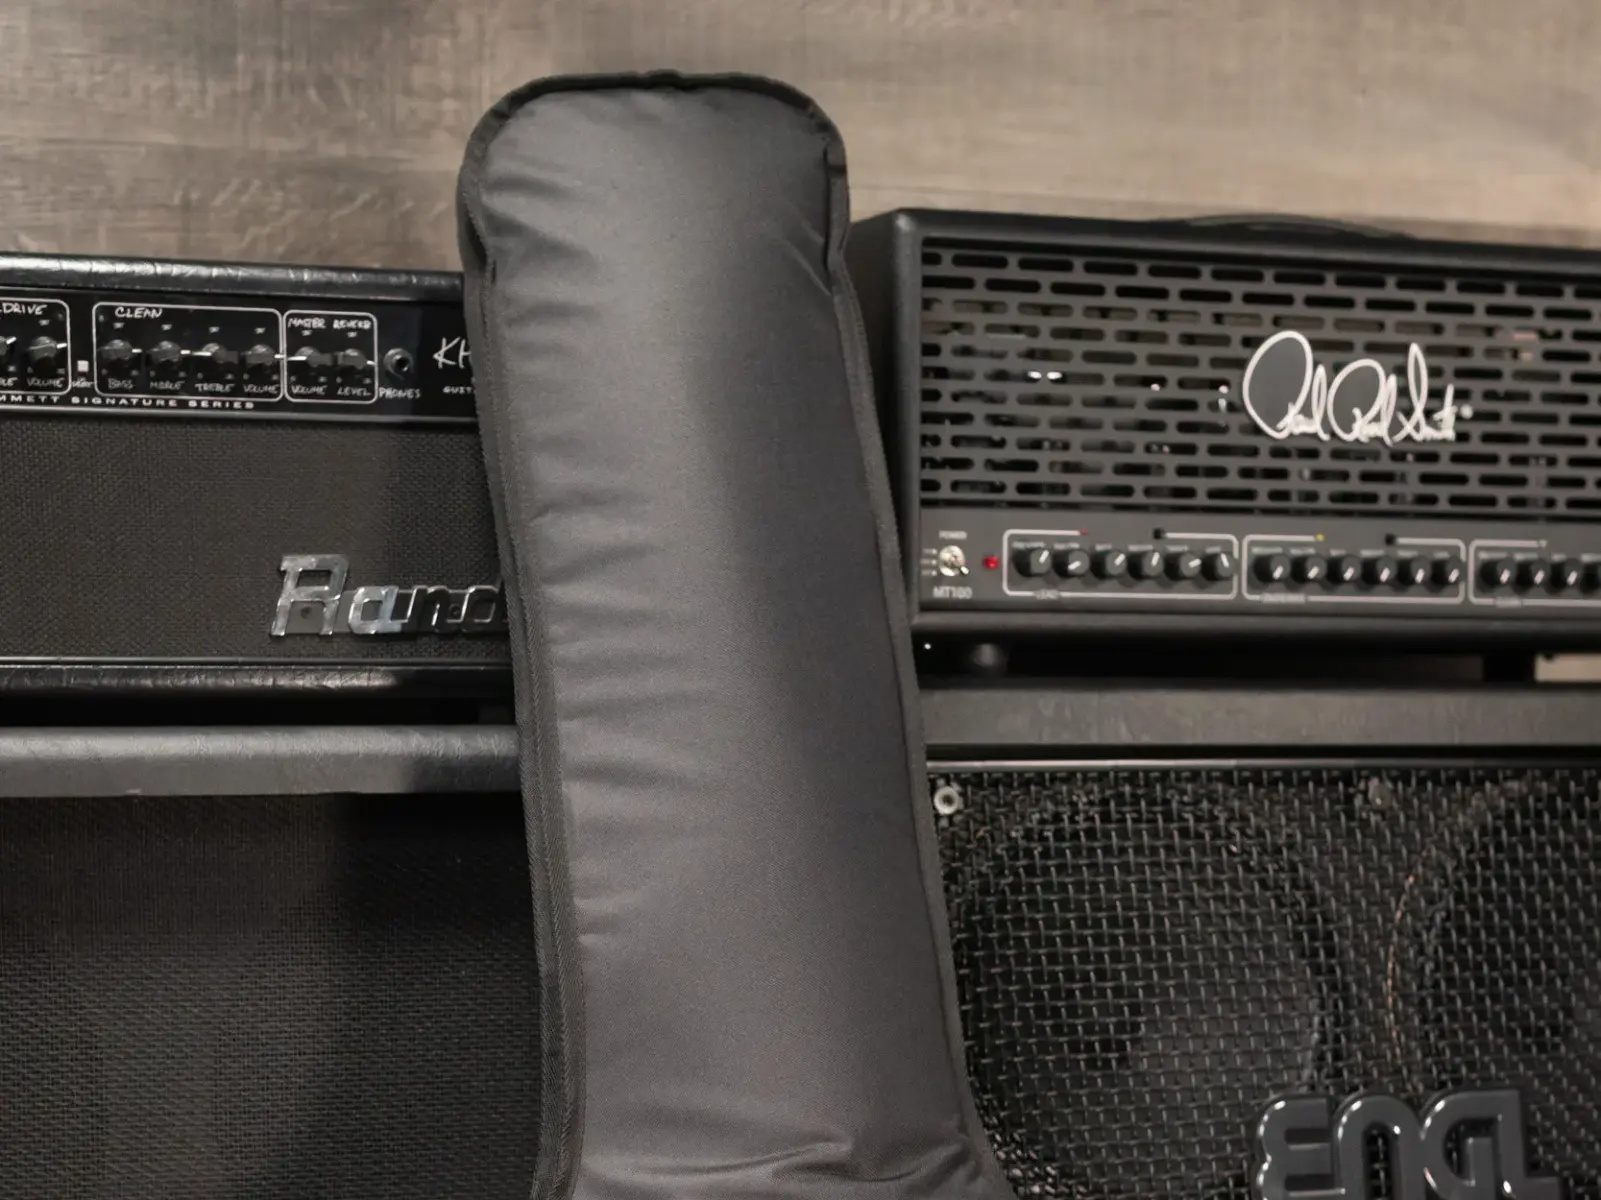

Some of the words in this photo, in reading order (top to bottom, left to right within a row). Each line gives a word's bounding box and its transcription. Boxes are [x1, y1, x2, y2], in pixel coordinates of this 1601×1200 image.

[0, 302, 48, 315] DRIVE
[114, 306, 163, 318] CLEAN
[288, 317, 326, 329] MASTER
[337, 386, 372, 396] LEVEL
[379, 387, 421, 399] PHONES
[71, 396, 177, 407] SIGNATURE
[188, 399, 255, 409] SERIES
